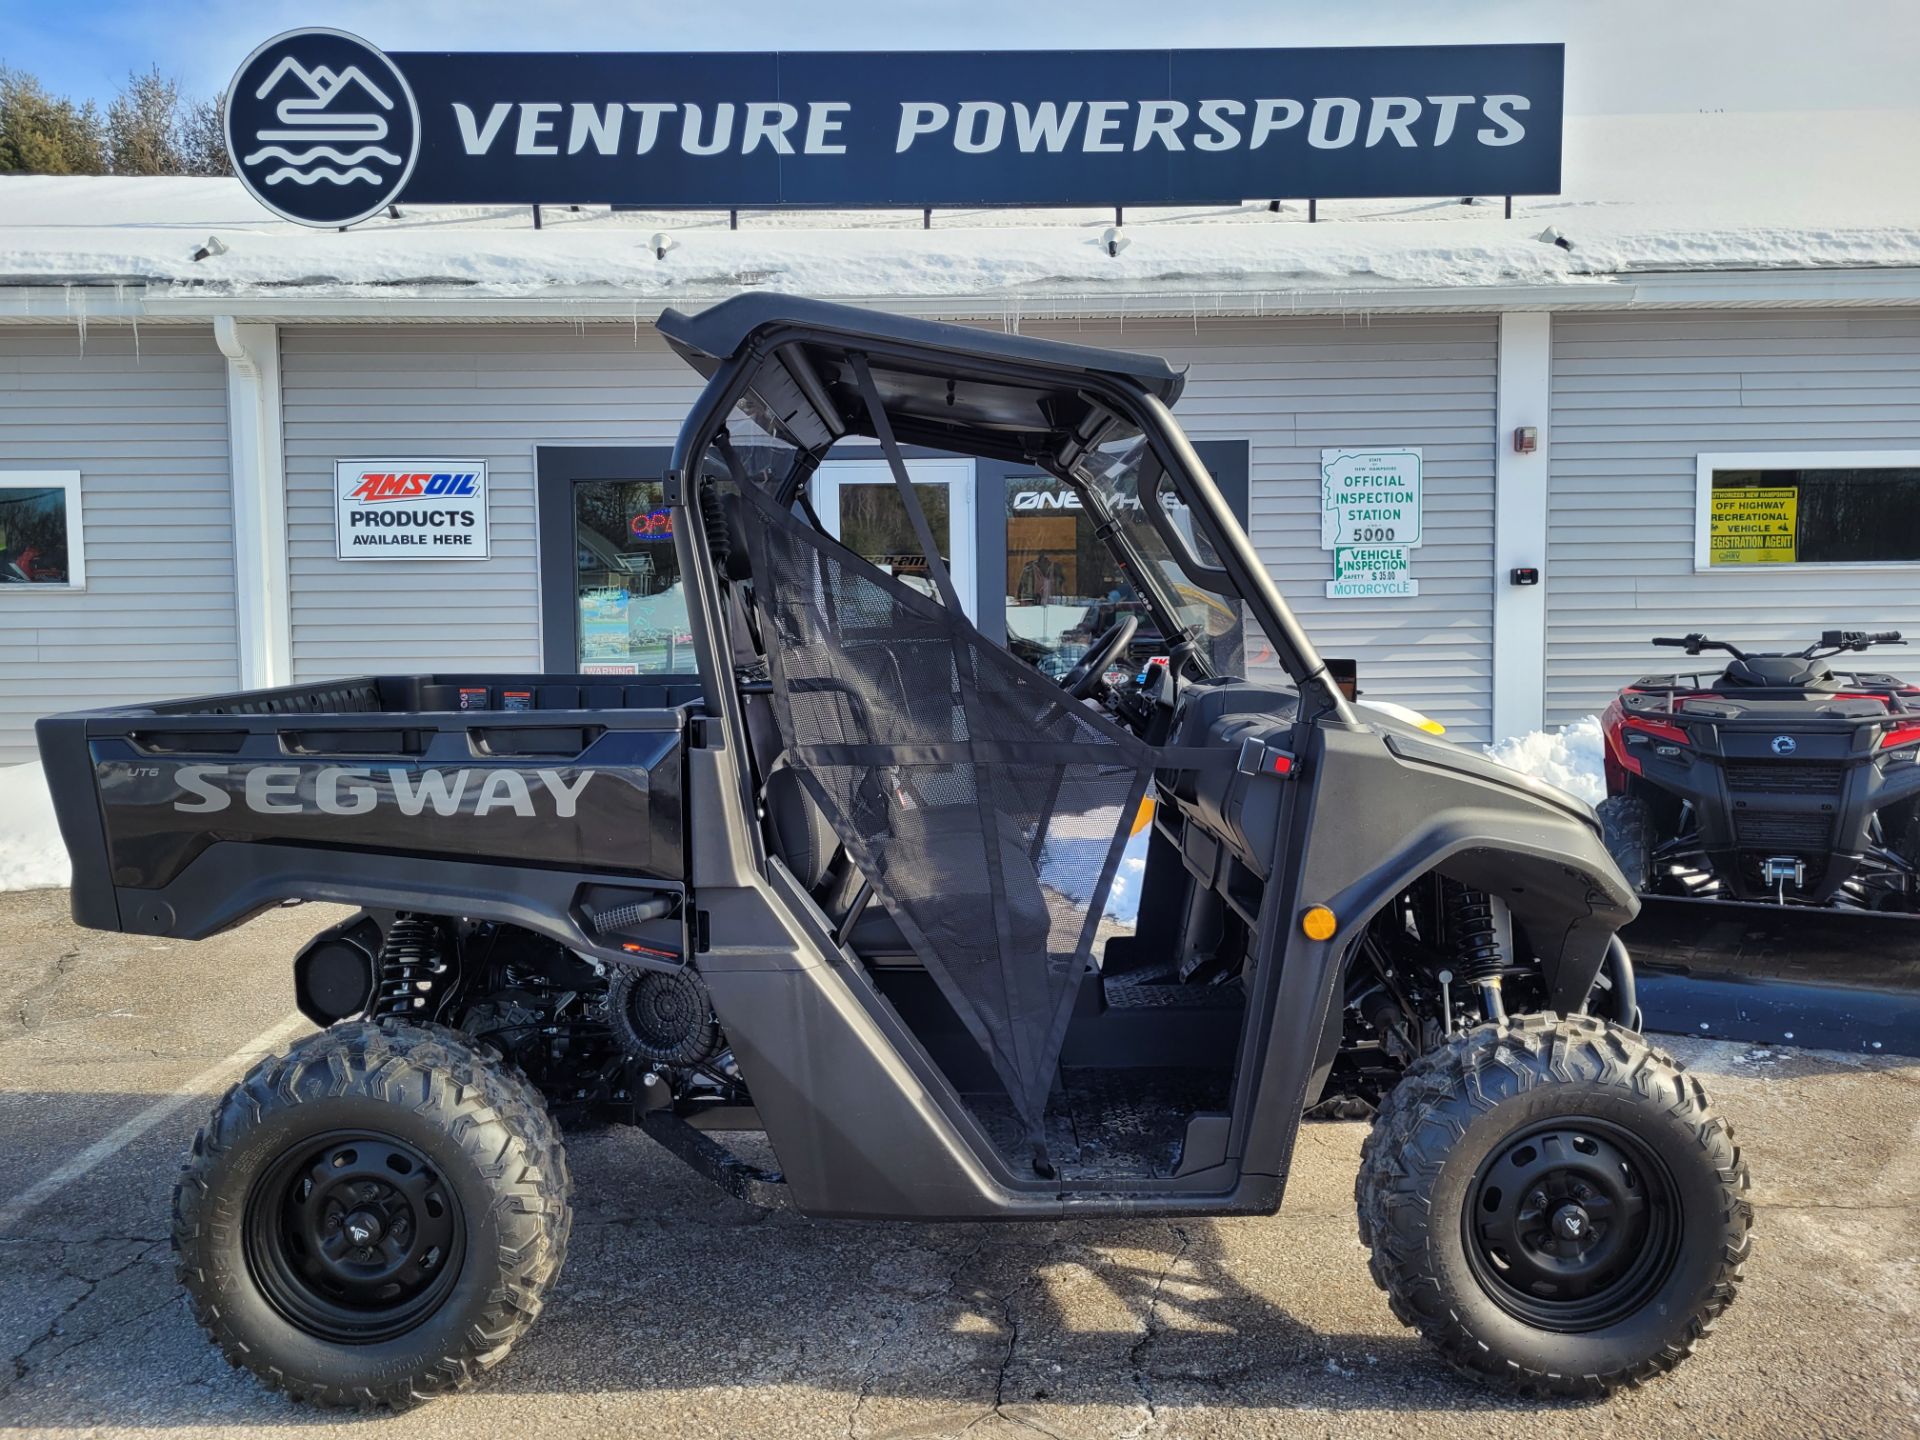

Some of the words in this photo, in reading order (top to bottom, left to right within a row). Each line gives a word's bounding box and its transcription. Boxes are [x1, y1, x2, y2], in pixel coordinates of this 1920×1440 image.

[452, 102, 851, 156] VENTURE
[896, 94, 1531, 154] POWERSPORTS
[350, 473, 477, 501] AMSOIL
[1344, 475, 1405, 488] OFFICIAL
[1336, 491, 1414, 504] INSPECTION
[1715, 501, 1736, 510] OFF
[1738, 501, 1786, 510] HIGHWAY
[350, 510, 476, 528] PRODUCTS
[1348, 509, 1402, 521] STATION
[1711, 513, 1789, 521] RECREATIONAL
[1353, 528, 1395, 542] 5000
[1727, 524, 1771, 533] VEHICLE
[352, 534, 428, 545] AVAILABLE
[432, 534, 473, 545] HERE
[1712, 535, 1764, 549] EGISTRATION
[1764, 535, 1792, 548] AGENT
[1351, 549, 1403, 560] VEHICLE
[1343, 560, 1407, 571] INSPECTION
[1334, 582, 1410, 595] MOTORCYCLE
[127, 767, 160, 777] UT6
[173, 765, 596, 818] SEGWAY
